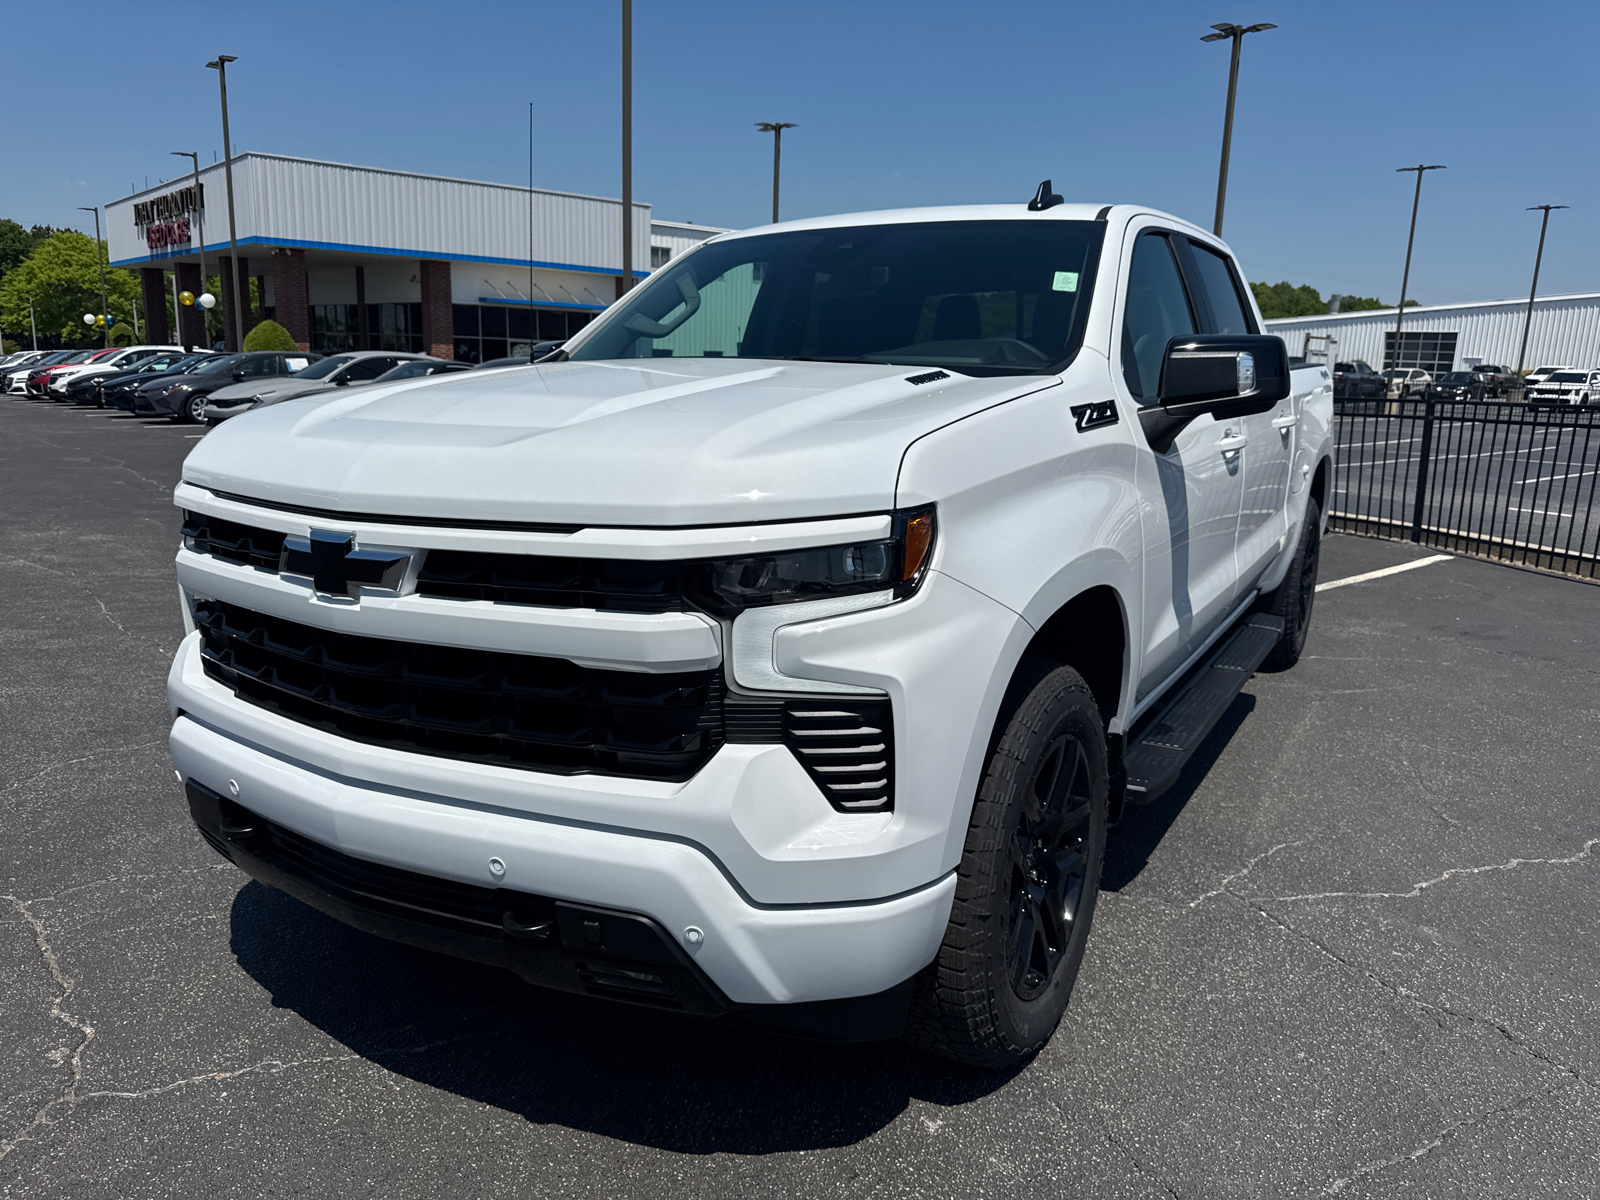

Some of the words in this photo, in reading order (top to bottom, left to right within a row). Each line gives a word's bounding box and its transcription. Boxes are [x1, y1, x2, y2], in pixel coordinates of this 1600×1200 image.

[153, 183, 204, 220] THORNTO
[146, 224, 167, 249] USED
[166, 218, 189, 245] CARS
[1069, 399, 1119, 434] Z71
